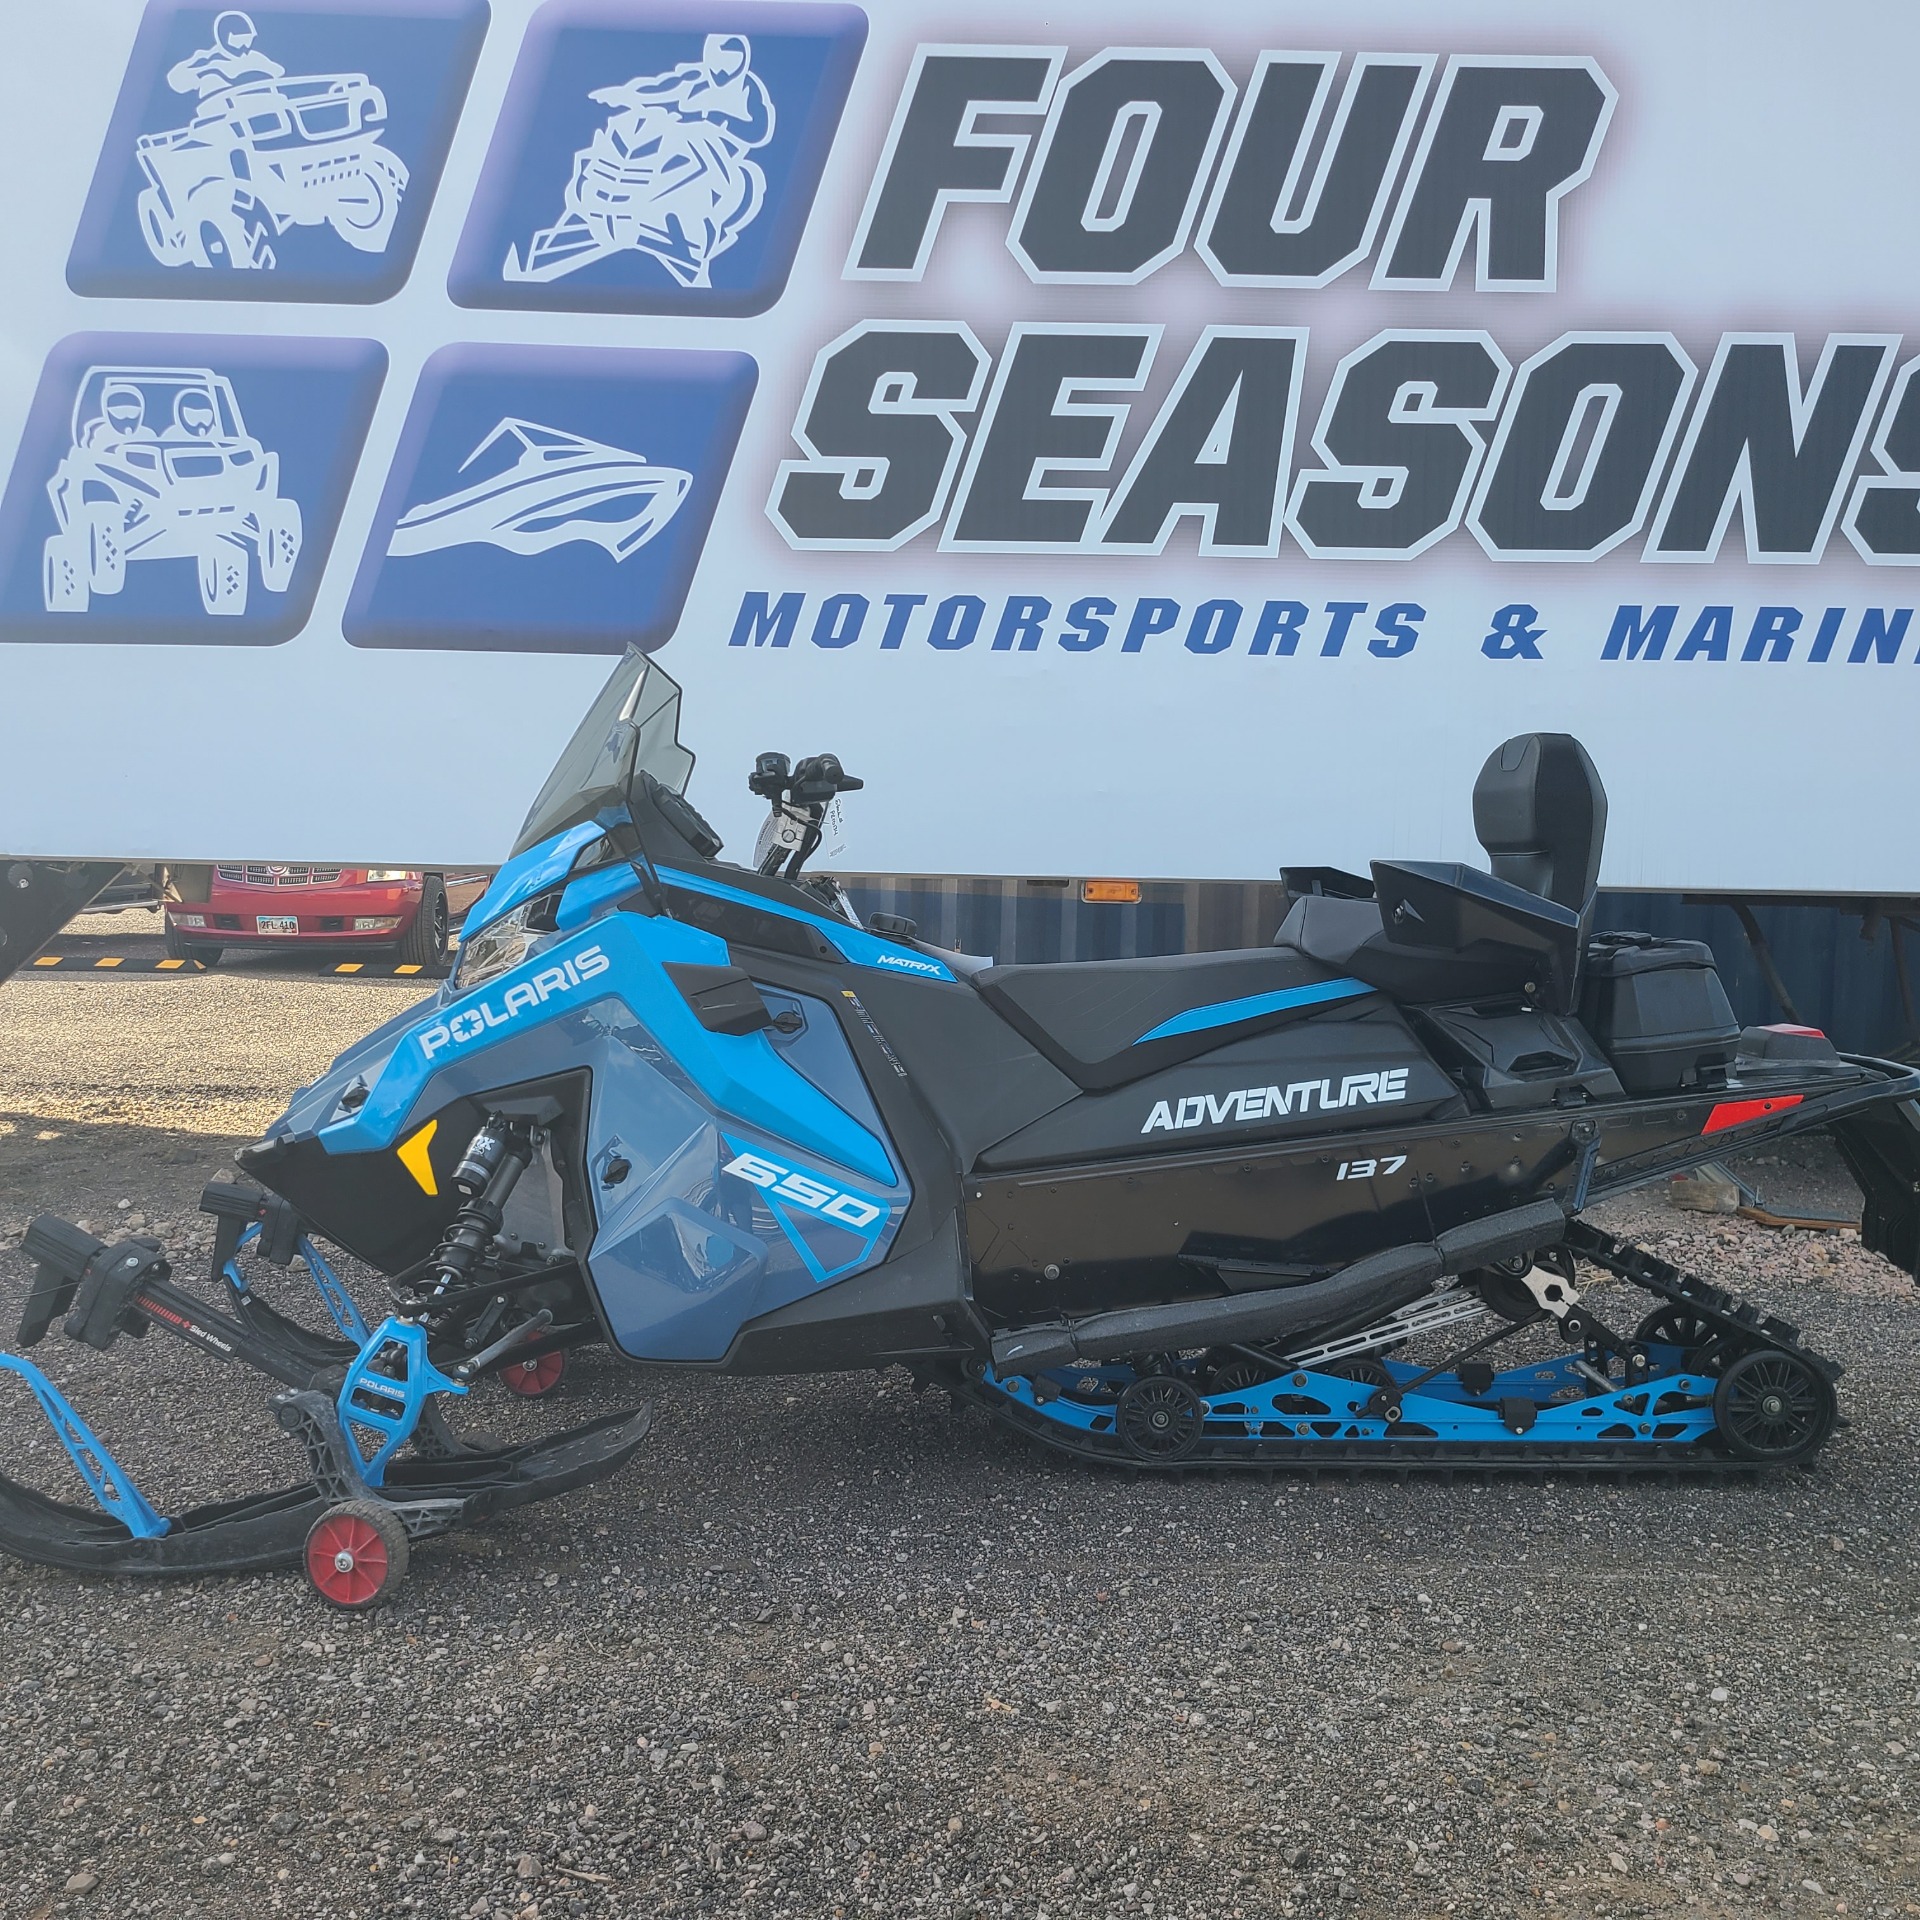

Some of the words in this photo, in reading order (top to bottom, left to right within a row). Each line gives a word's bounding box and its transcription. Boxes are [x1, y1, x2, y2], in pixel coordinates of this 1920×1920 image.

[841, 43, 1620, 293] FOUR
[727, 590, 1427, 660] MOTORSPORTS
[1480, 603, 1549, 661] &
[1599, 604, 1920, 666] MARIN
[279, 920, 295, 930] 410
[877, 954, 941, 976] MATRYX
[419, 945, 610, 1059] POLARIS
[1140, 1068, 1409, 1134] ADVENTURE
[722, 1152, 880, 1228] 650
[1336, 1155, 1407, 1181] 137
[189, 1324, 208, 1338] Sled
[205, 1332, 232, 1352] Wheels
[360, 1377, 406, 1398] POLARIS
